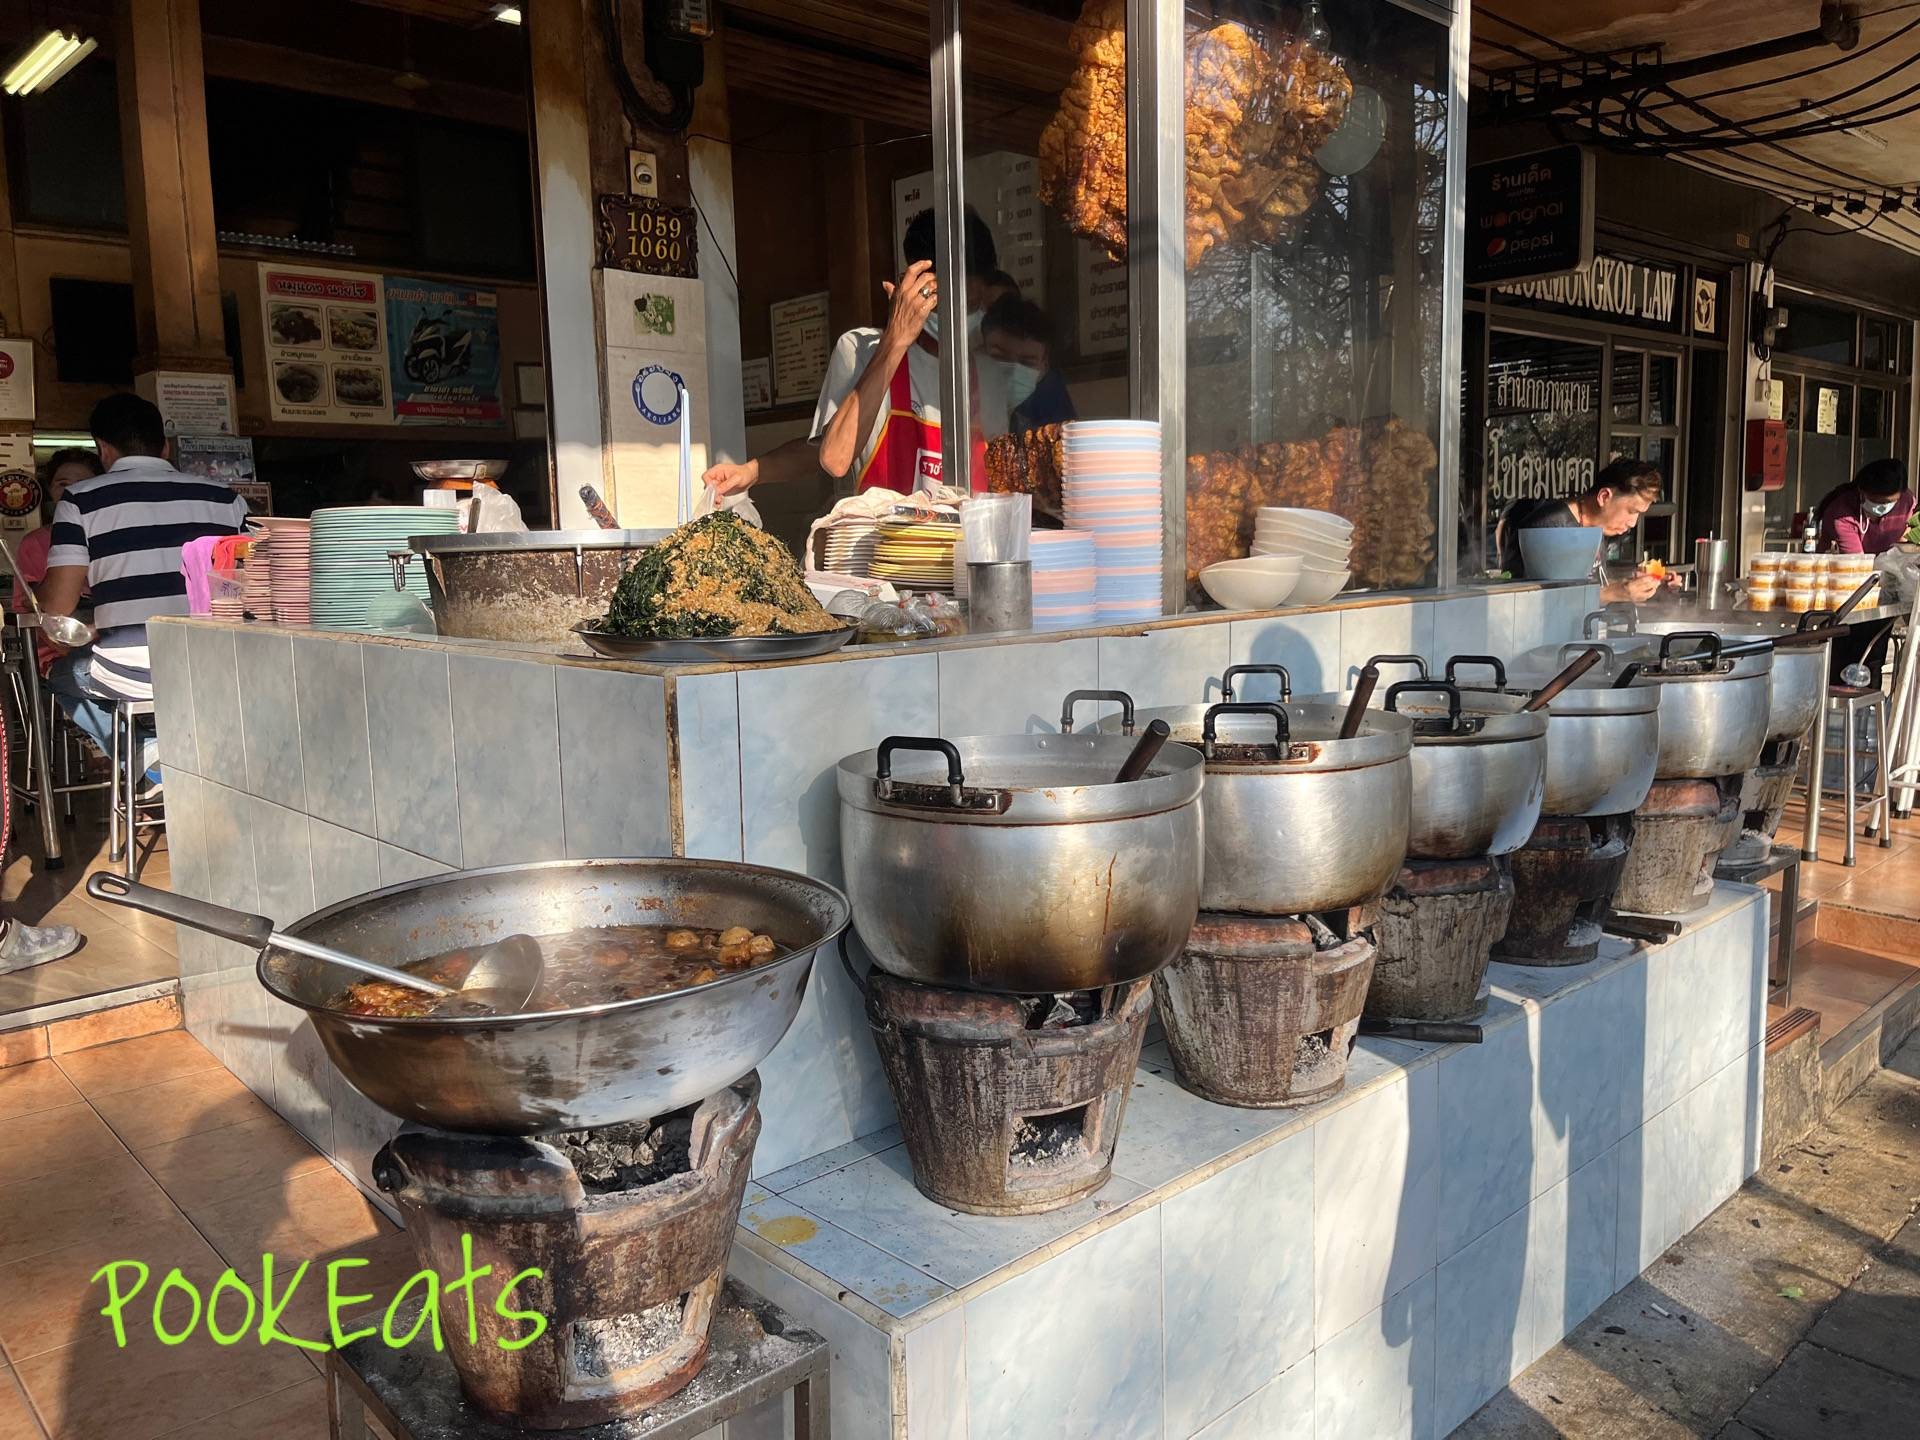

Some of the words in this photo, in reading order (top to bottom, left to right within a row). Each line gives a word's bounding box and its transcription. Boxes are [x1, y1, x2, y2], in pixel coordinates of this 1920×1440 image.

[1490, 161, 1552, 191] ร้านเด็ด
[626, 211, 682, 239] 1059
[1480, 200, 1564, 229] wongnai
[627, 235, 682, 262] 1060
[1510, 232, 1553, 255] pepsi
[1496, 255, 1636, 317] MONGKOL
[1641, 267, 1676, 323] LAW
[1497, 364, 1590, 424] สำนักกฎหมาย
[1489, 422, 1595, 500] โชคมงคล
